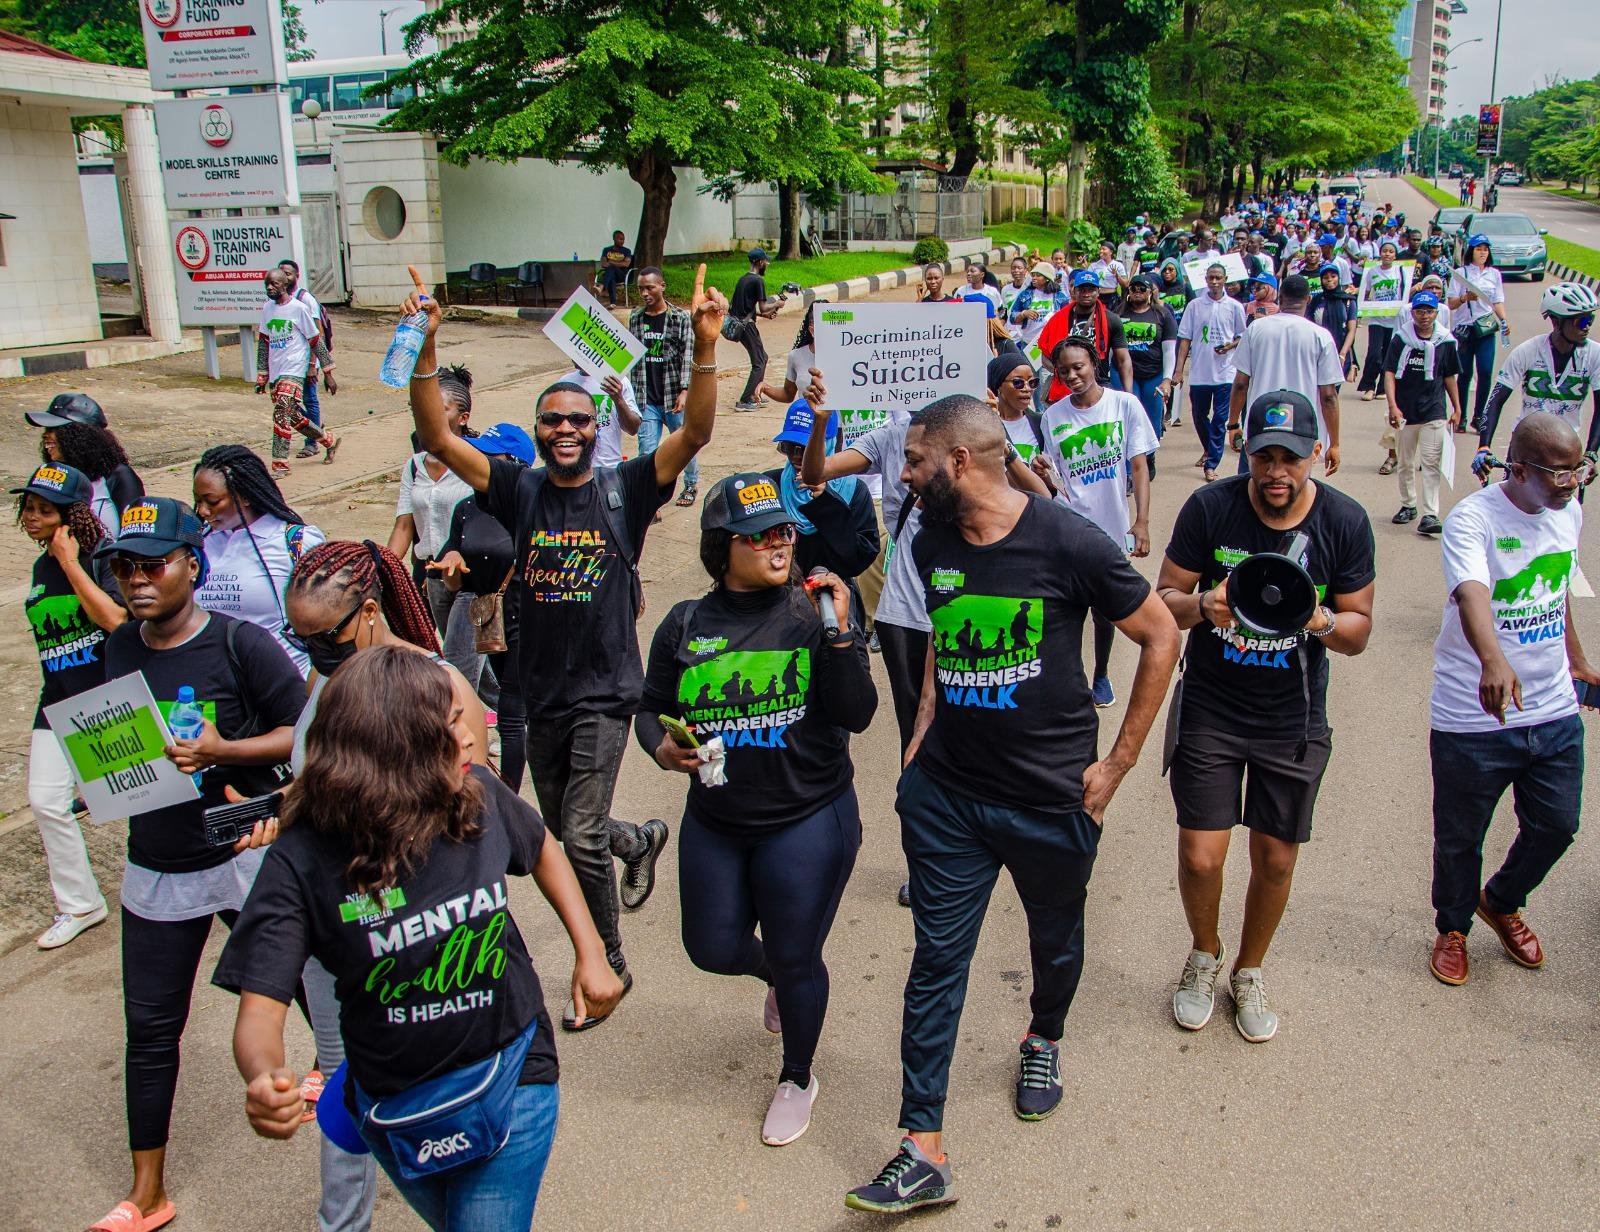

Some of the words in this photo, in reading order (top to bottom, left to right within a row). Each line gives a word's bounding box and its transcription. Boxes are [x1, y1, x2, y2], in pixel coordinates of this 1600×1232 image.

[186, 9, 220, 22] FUND
[178, 30, 213, 38] CORPORATE
[166, 158, 196, 170] MODEL
[198, 157, 230, 168] SKILLS
[231, 155, 278, 166] TRAINING
[205, 170, 240, 180] CENTRE
[212, 227, 284, 240] INDUSTRIAL
[214, 241, 270, 254] TRAINING
[215, 254, 247, 266] FUND
[578, 320, 616, 358] Mental
[584, 305, 627, 350] Nigerian
[841, 325, 964, 346] Decriminalize
[569, 332, 604, 368] Health
[870, 344, 942, 360] Attempted
[852, 356, 961, 387] Suicide
[870, 391, 882, 403] in
[888, 388, 937, 404] Nigeria
[47, 470, 63, 481] 112
[1080, 465, 1117, 485] WALK
[754, 486, 775, 498] 112
[130, 510, 153, 521] 112
[530, 530, 606, 546] MENTAL
[525, 549, 616, 588] health
[201, 594, 240, 602] HEALTH
[536, 592, 544, 601] IS
[545, 592, 591, 602] HEALTH
[1497, 604, 1545, 618] MENTAL
[40, 630, 104, 660] WARENESS
[1224, 644, 1290, 669] WALK
[46, 646, 98, 672] WALK
[976, 646, 1036, 671] HEALTH
[685, 707, 743, 721] MENTAL
[748, 694, 805, 715] HEALTH
[944, 683, 1018, 709] WALK
[70, 700, 137, 739] Nigerian
[696, 705, 806, 734] AWARENESS
[88, 727, 146, 767] Mental
[104, 757, 159, 795] Health
[368, 882, 506, 958] MENTAL
[365, 912, 507, 1004] health
[388, 1007, 406, 1024] IS
[412, 990, 493, 1023] HEALTH
[432, 1132, 470, 1158] asics
